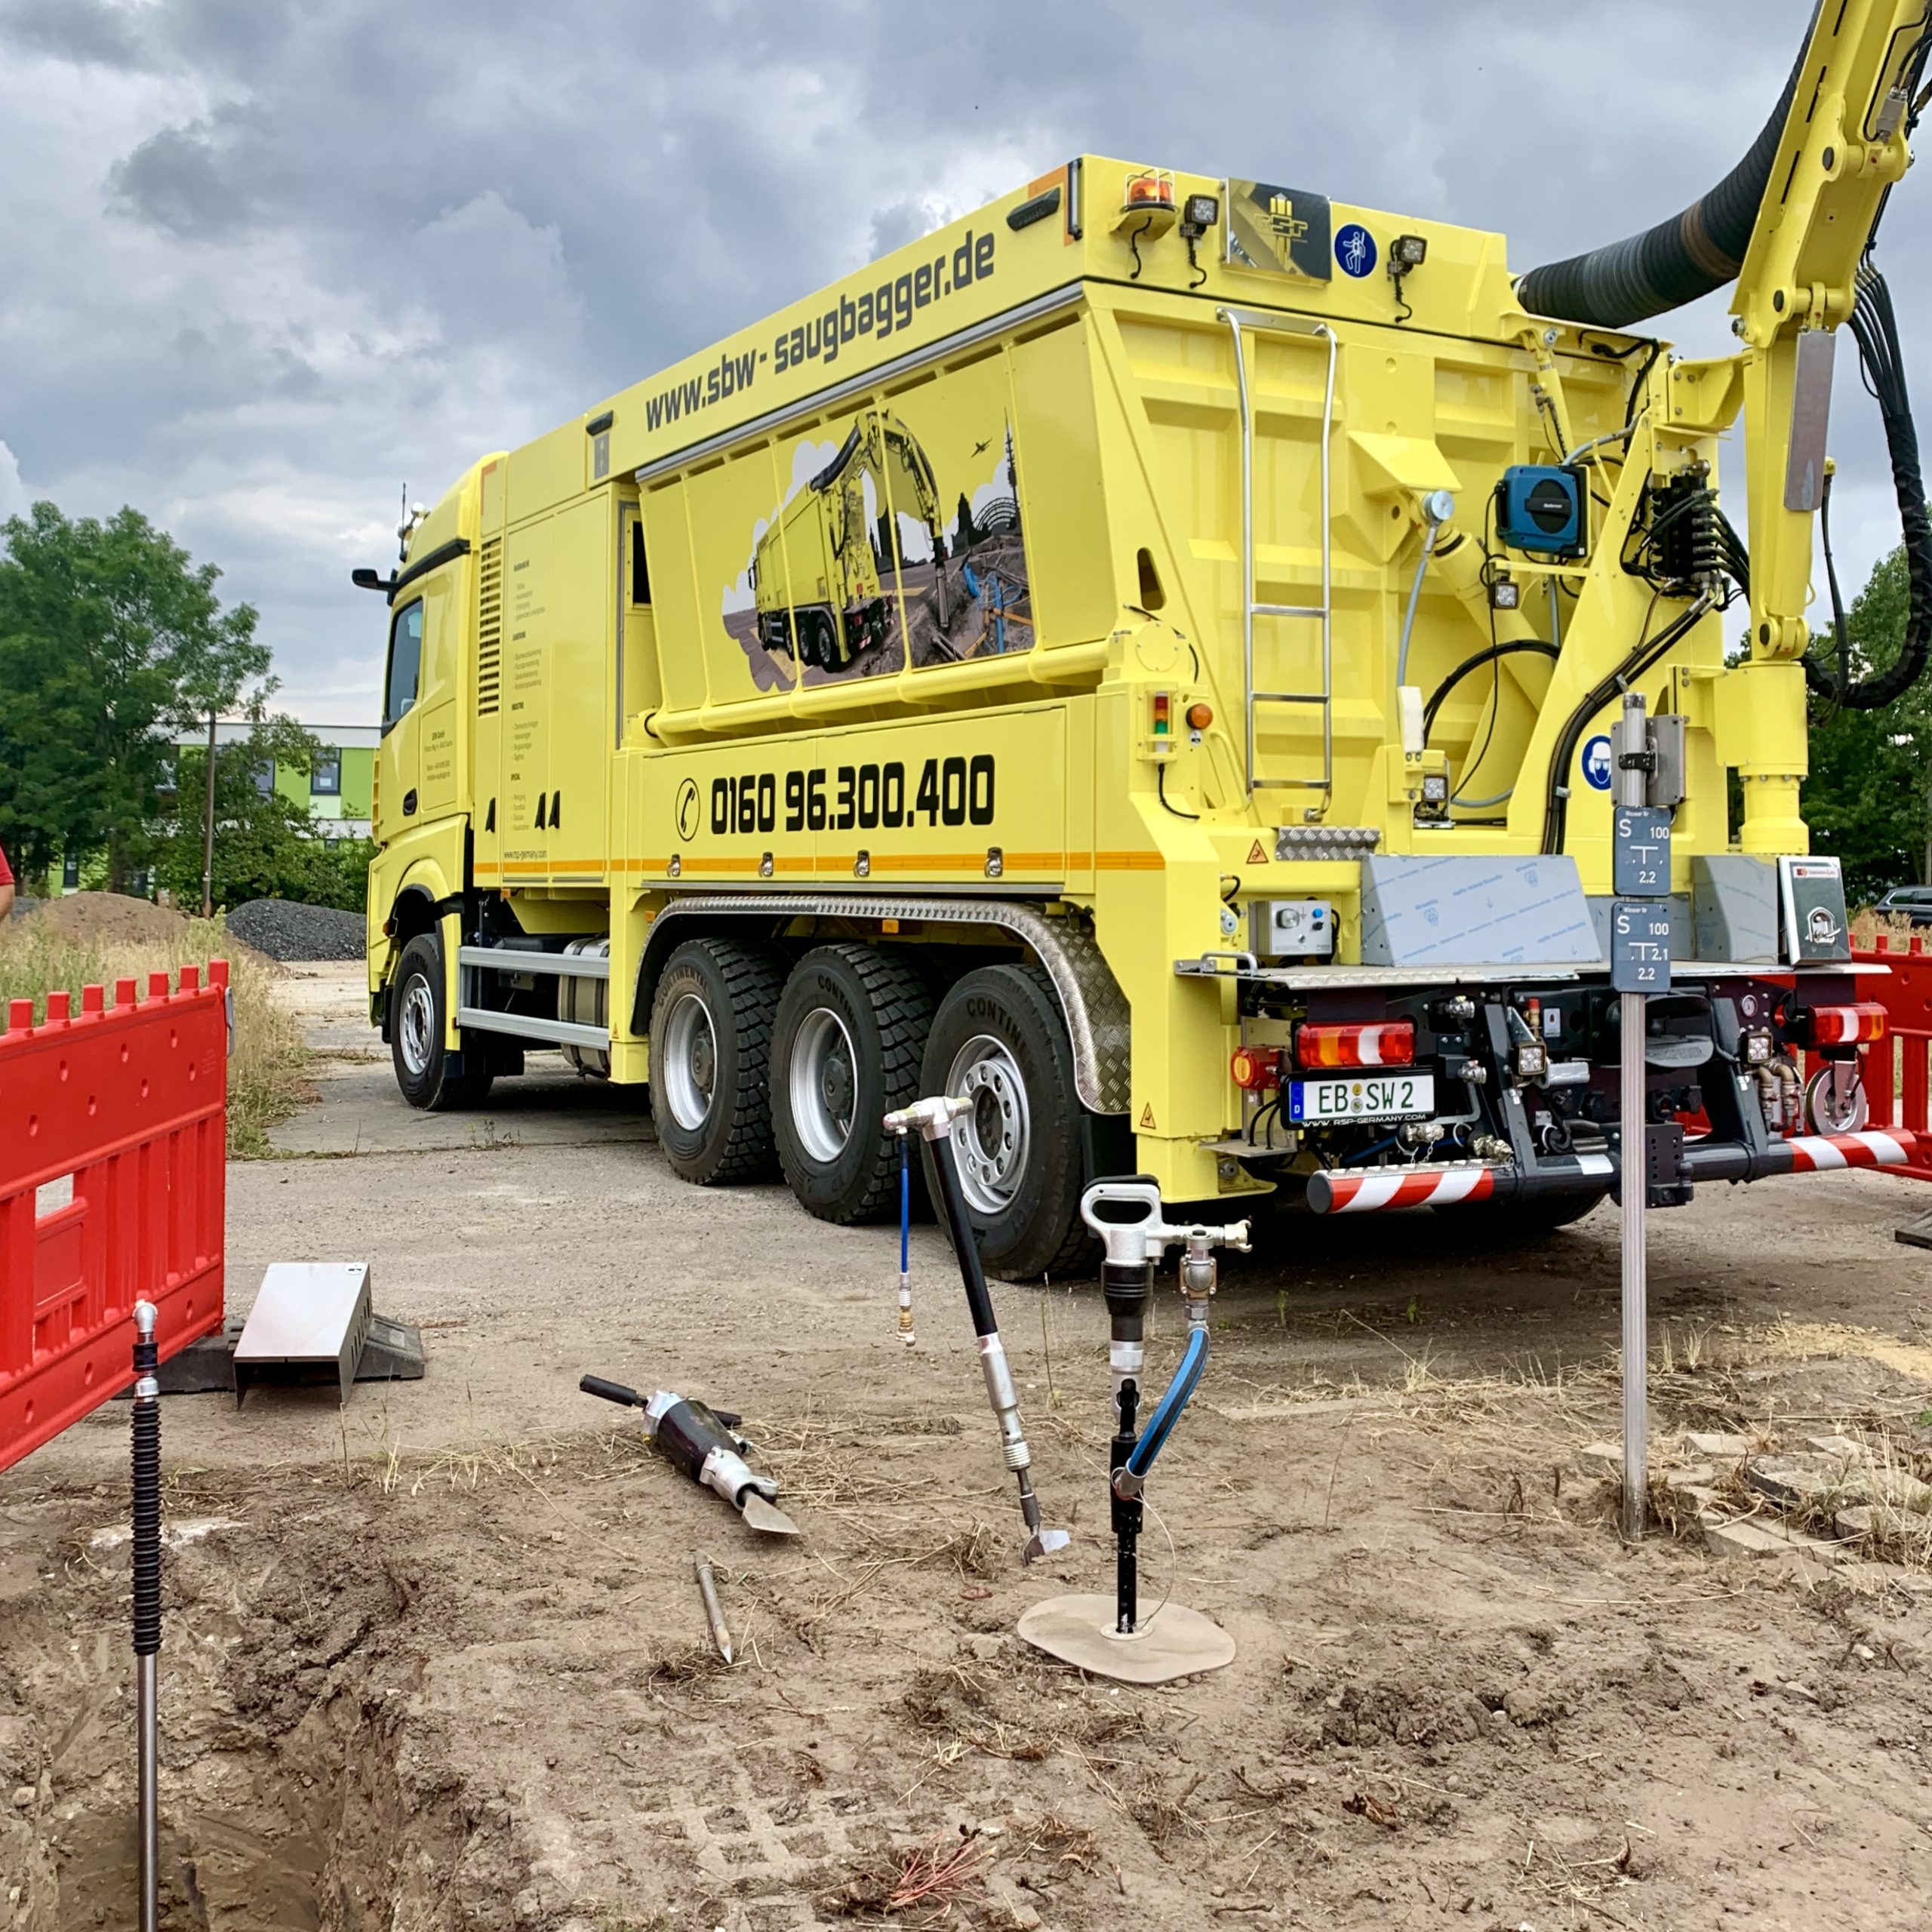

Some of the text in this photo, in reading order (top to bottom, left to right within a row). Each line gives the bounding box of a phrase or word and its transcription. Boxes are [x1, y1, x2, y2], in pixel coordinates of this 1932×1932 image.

[712, 754, 995, 835] 0160 96.300.400
[1619, 819, 1669, 839] S 100
[1617, 915, 1669, 935] S 100
[1294, 1081, 1414, 1114] D EB SW 2
